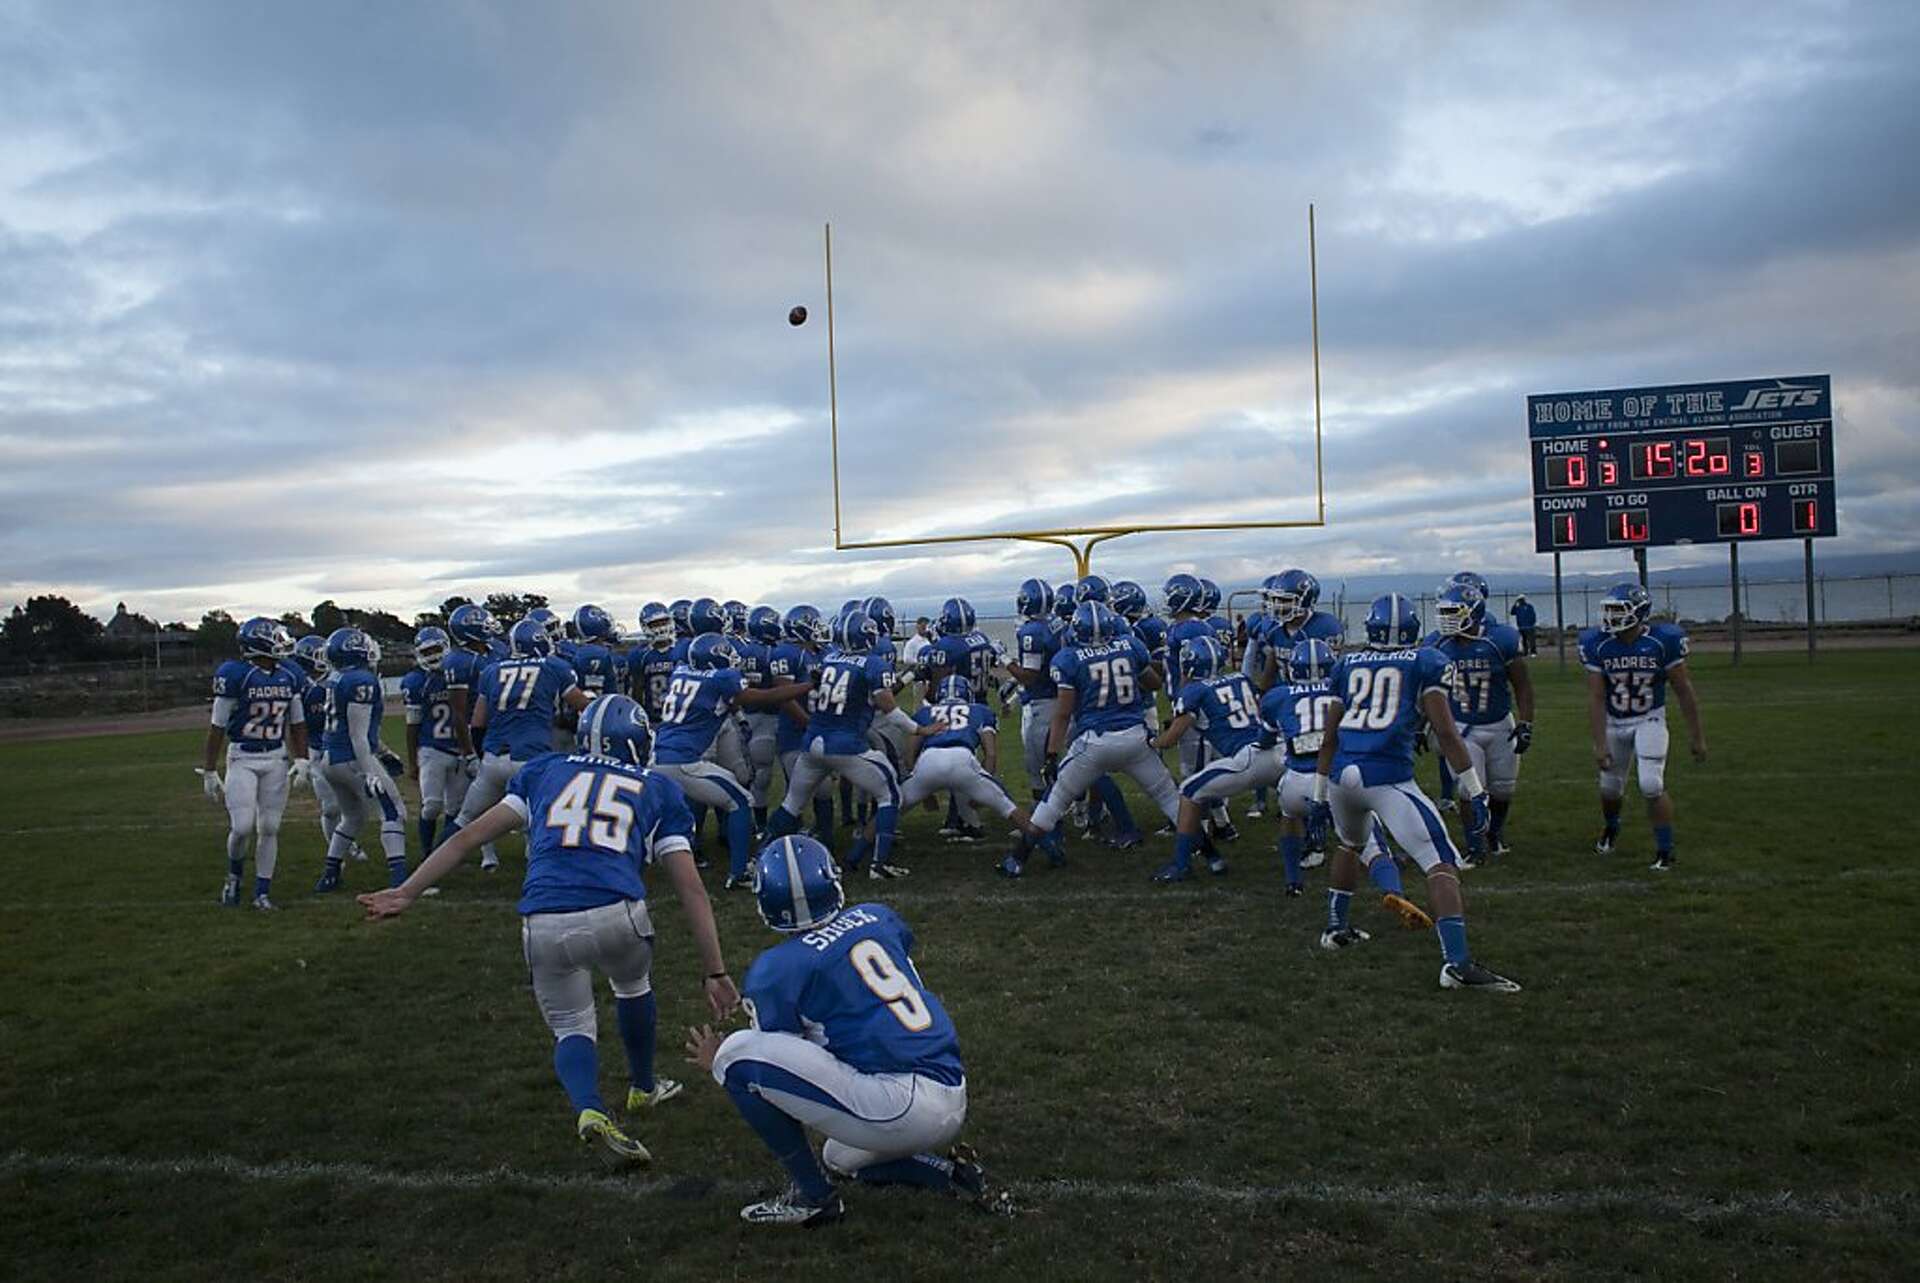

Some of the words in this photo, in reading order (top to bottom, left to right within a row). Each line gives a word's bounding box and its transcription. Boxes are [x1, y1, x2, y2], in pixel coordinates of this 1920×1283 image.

[1535, 399, 1612, 423] HOME
[1623, 396, 1657, 417] OF
[1667, 391, 1724, 415] THE
[1730, 386, 1823, 411] JETS
[1542, 439, 1589, 454] HOME
[1770, 424, 1824, 440] GUEST
[1567, 455, 1585, 487] 0
[1603, 462, 1616, 484] 3
[1749, 454, 1761, 475] 3
[1541, 497, 1588, 511] DOWN
[1606, 495, 1625, 507] TO
[1627, 493, 1648, 505] GO
[1706, 488, 1742, 501] BALL
[1745, 486, 1767, 499] ON
[1788, 483, 1819, 496] QTR
[1740, 503, 1758, 534] 0
[1603, 655, 1657, 670] PADRES
[248, 685, 293, 698] PADRES
[498, 666, 541, 711] 77
[818, 666, 850, 716] 64
[1089, 657, 1134, 707] 76
[1610, 672, 1656, 712] 33
[661, 678, 702, 724] 67
[1339, 666, 1402, 730] 20
[242, 701, 288, 740] 23
[431, 703, 452, 739] 2
[547, 771, 644, 854] 45
[850, 939, 932, 1033] 9
